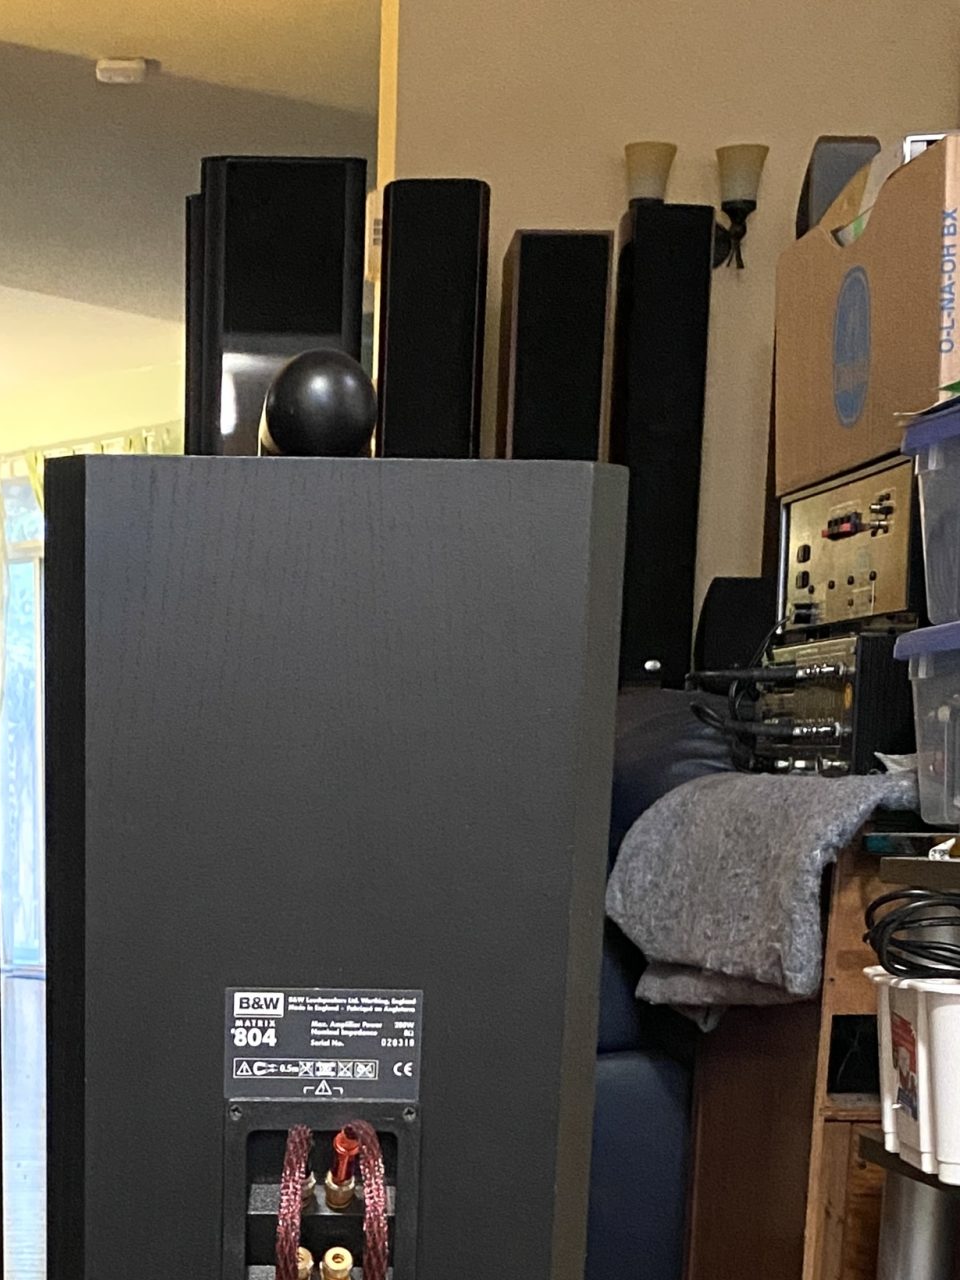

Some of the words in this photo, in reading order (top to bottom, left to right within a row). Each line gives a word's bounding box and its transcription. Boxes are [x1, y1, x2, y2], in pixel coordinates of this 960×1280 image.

[942, 207, 958, 237] BX
[239, 997, 280, 1010] B&W
[235, 1019, 275, 1027] MATRIX
[330, 1020, 361, 1029] Amplifier
[341, 1029, 378, 1037] Impedance
[393, 1062, 413, 1077] CE
